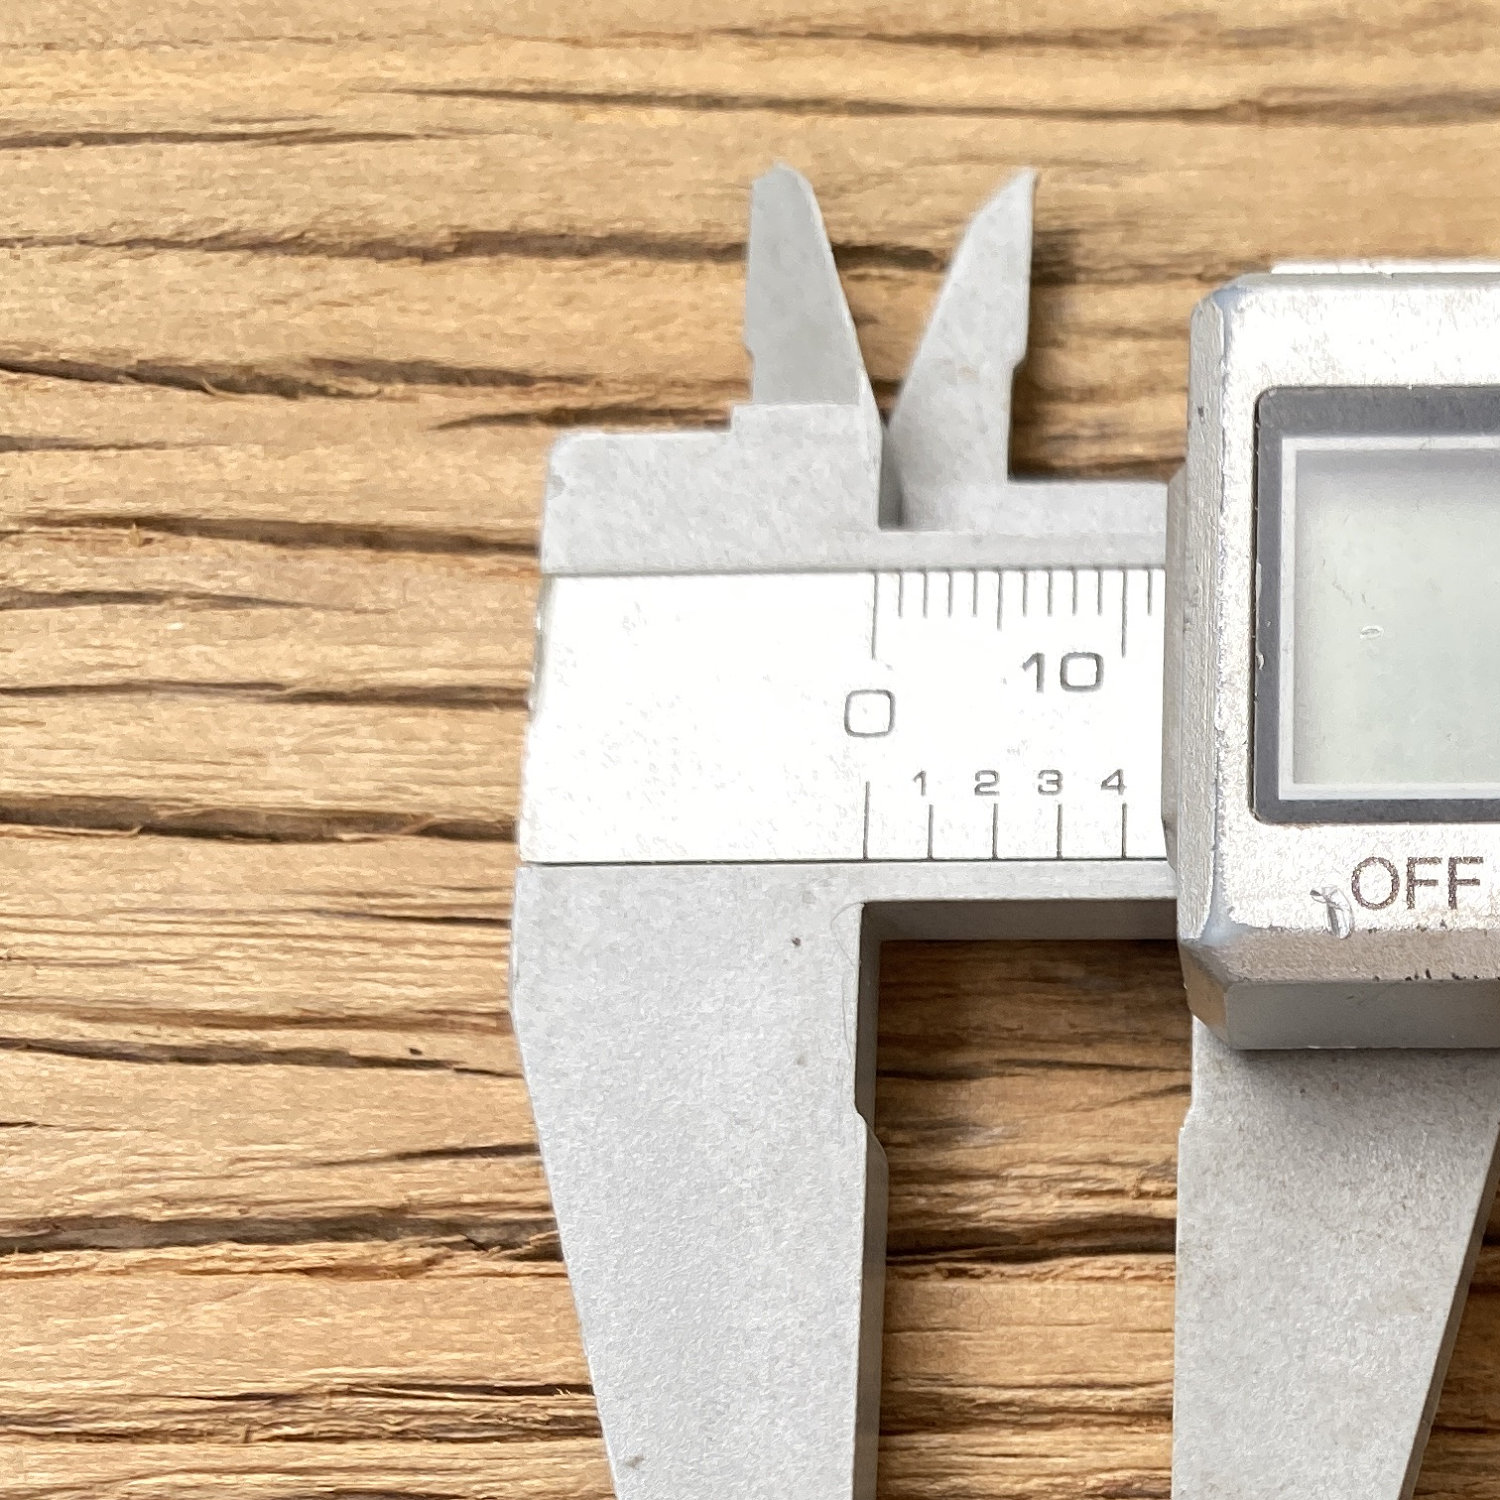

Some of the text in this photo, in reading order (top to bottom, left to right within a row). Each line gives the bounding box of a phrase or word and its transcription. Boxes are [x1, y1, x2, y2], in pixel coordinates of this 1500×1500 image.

[1021, 652, 1103, 692] 10
[912, 768, 1127, 796] 1 2 3 4
[1350, 856, 1484, 911] OFF
